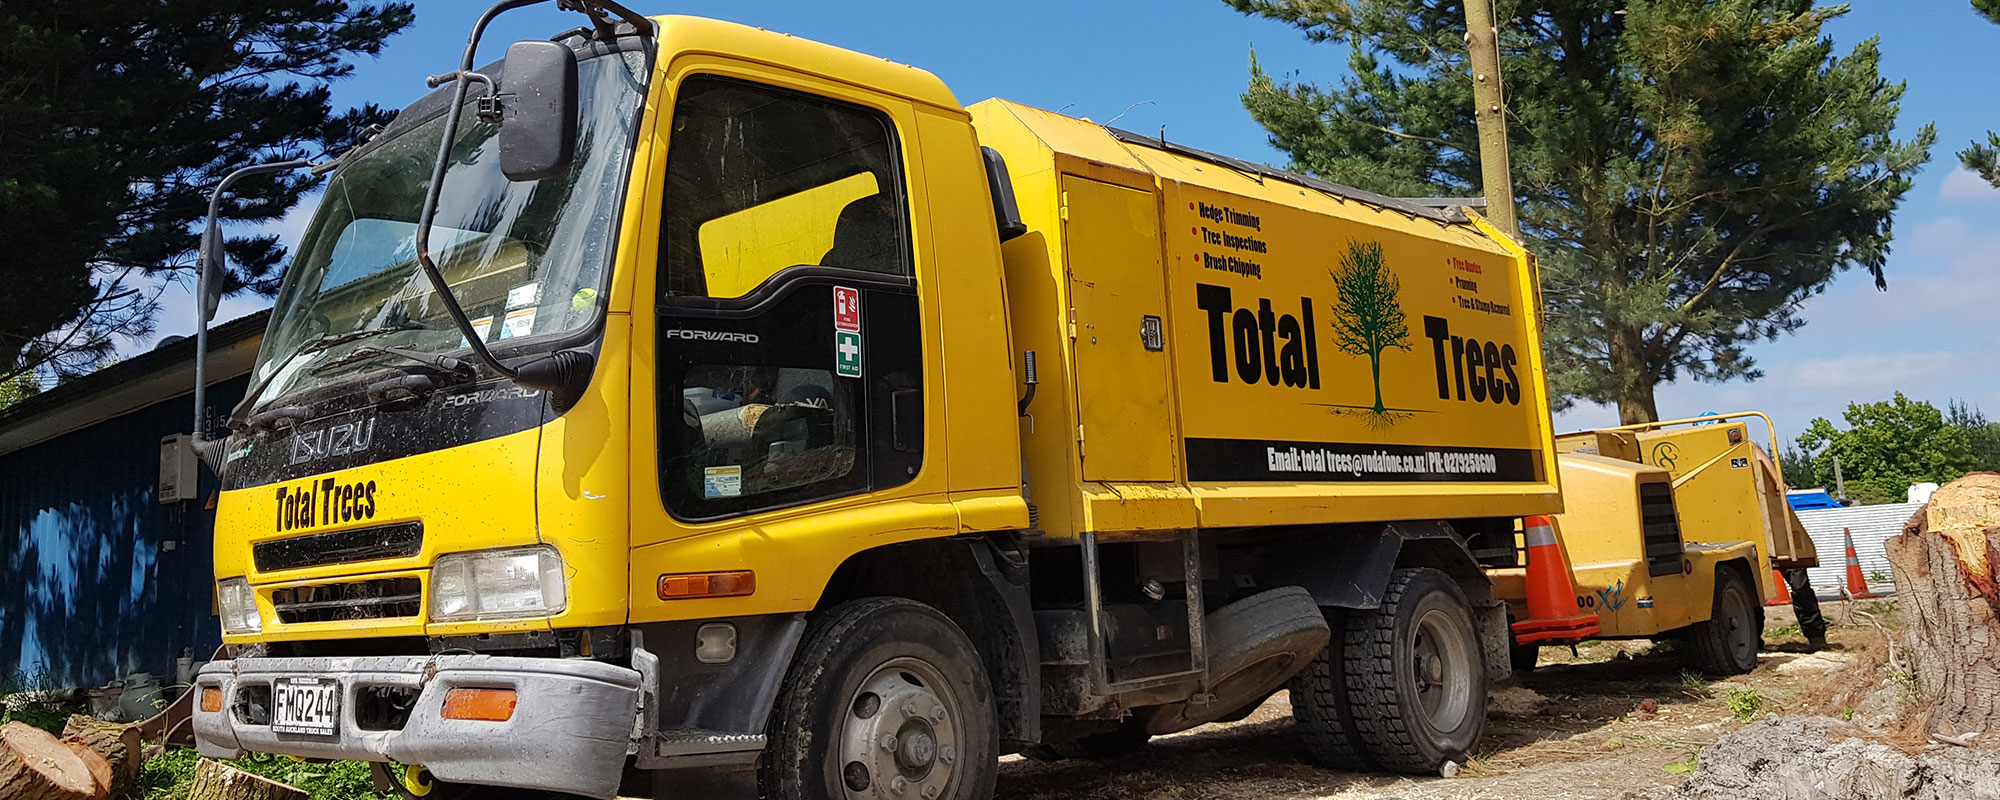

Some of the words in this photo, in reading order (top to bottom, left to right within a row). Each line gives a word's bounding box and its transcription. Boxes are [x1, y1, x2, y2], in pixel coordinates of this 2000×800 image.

[1198, 201, 1223, 224] Hedge
[1223, 206, 1261, 232] Trimming
[1201, 226, 1221, 245] Tree
[1222, 230, 1267, 254] Inspections
[1203, 251, 1228, 272] Brush
[1228, 256, 1262, 280] Chipping
[1453, 257, 1465, 271] Free
[1464, 260, 1482, 275] Quotes
[1457, 295, 1470, 309] Tree
[1475, 298, 1490, 315] Stump
[1489, 301, 1511, 316] Removal
[666, 329, 760, 343] FORWARD
[1196, 282, 1321, 390] Total
[1423, 314, 1521, 406] Trees
[442, 387, 541, 409] FORWARD
[290, 417, 375, 465] ISUZU
[275, 479, 318, 532] Total
[321, 477, 377, 526] Trees
[275, 688, 334, 723] FMQ244
